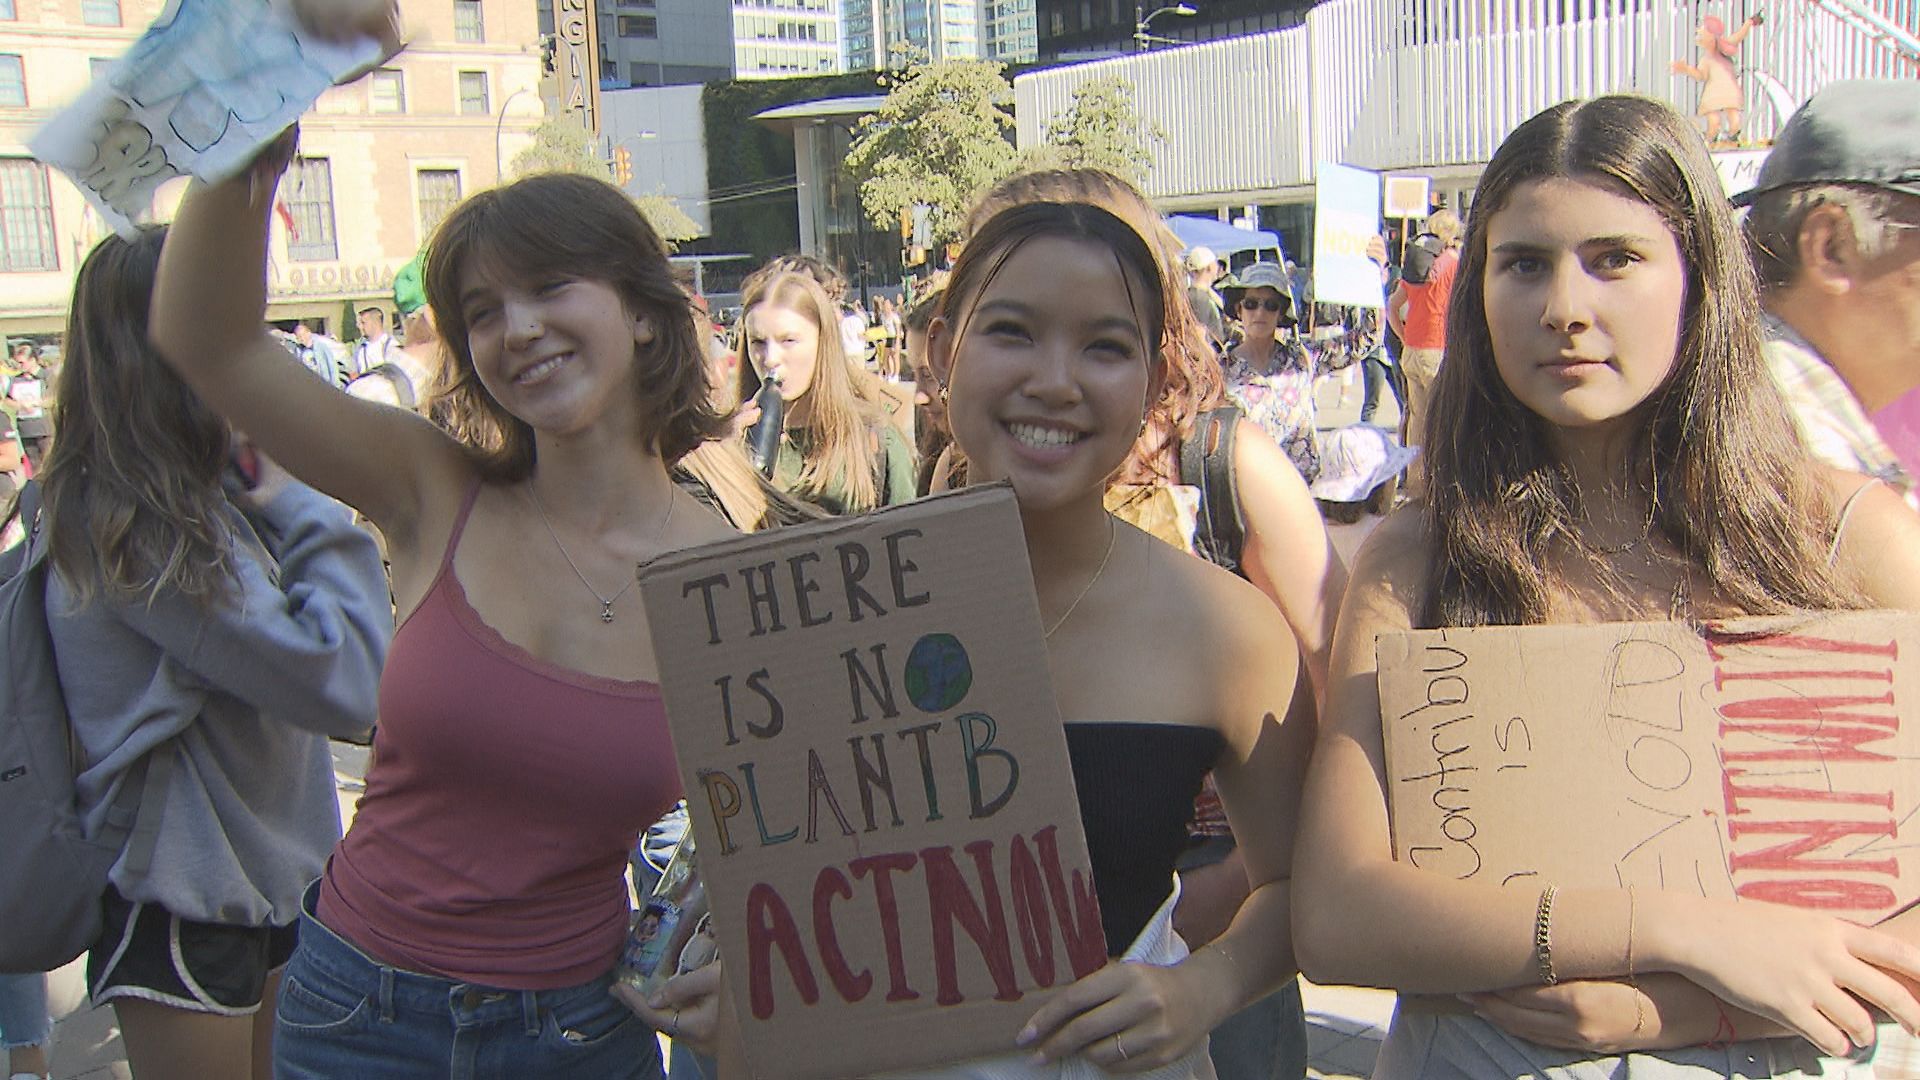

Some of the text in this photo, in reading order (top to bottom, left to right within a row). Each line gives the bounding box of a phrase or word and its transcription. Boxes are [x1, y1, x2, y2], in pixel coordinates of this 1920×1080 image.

[289, 264, 395, 290] GEORGIA
[682, 528, 931, 645] THERE
[714, 667, 784, 746] IS
